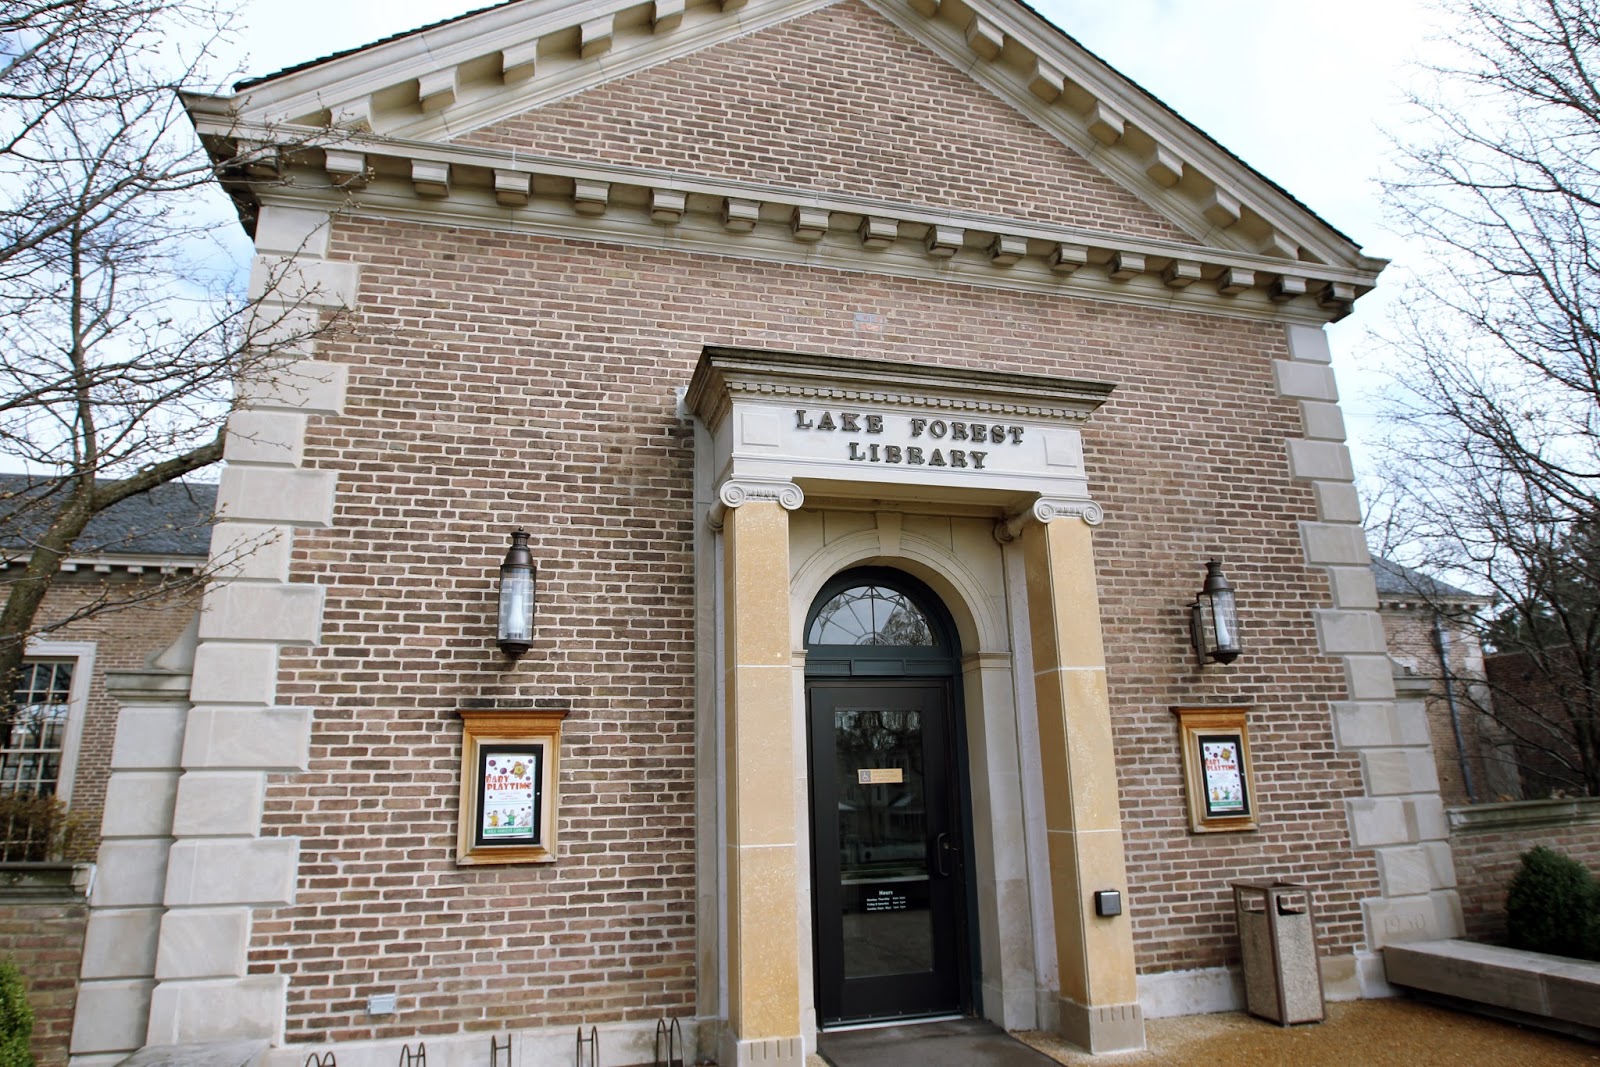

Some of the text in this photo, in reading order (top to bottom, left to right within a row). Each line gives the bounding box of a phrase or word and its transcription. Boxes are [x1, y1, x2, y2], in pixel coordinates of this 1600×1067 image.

[796, 409, 1024, 444] LAKE FOREST
[849, 442, 988, 469] LIBRARY
[487, 782, 532, 790] PLAYTIME
